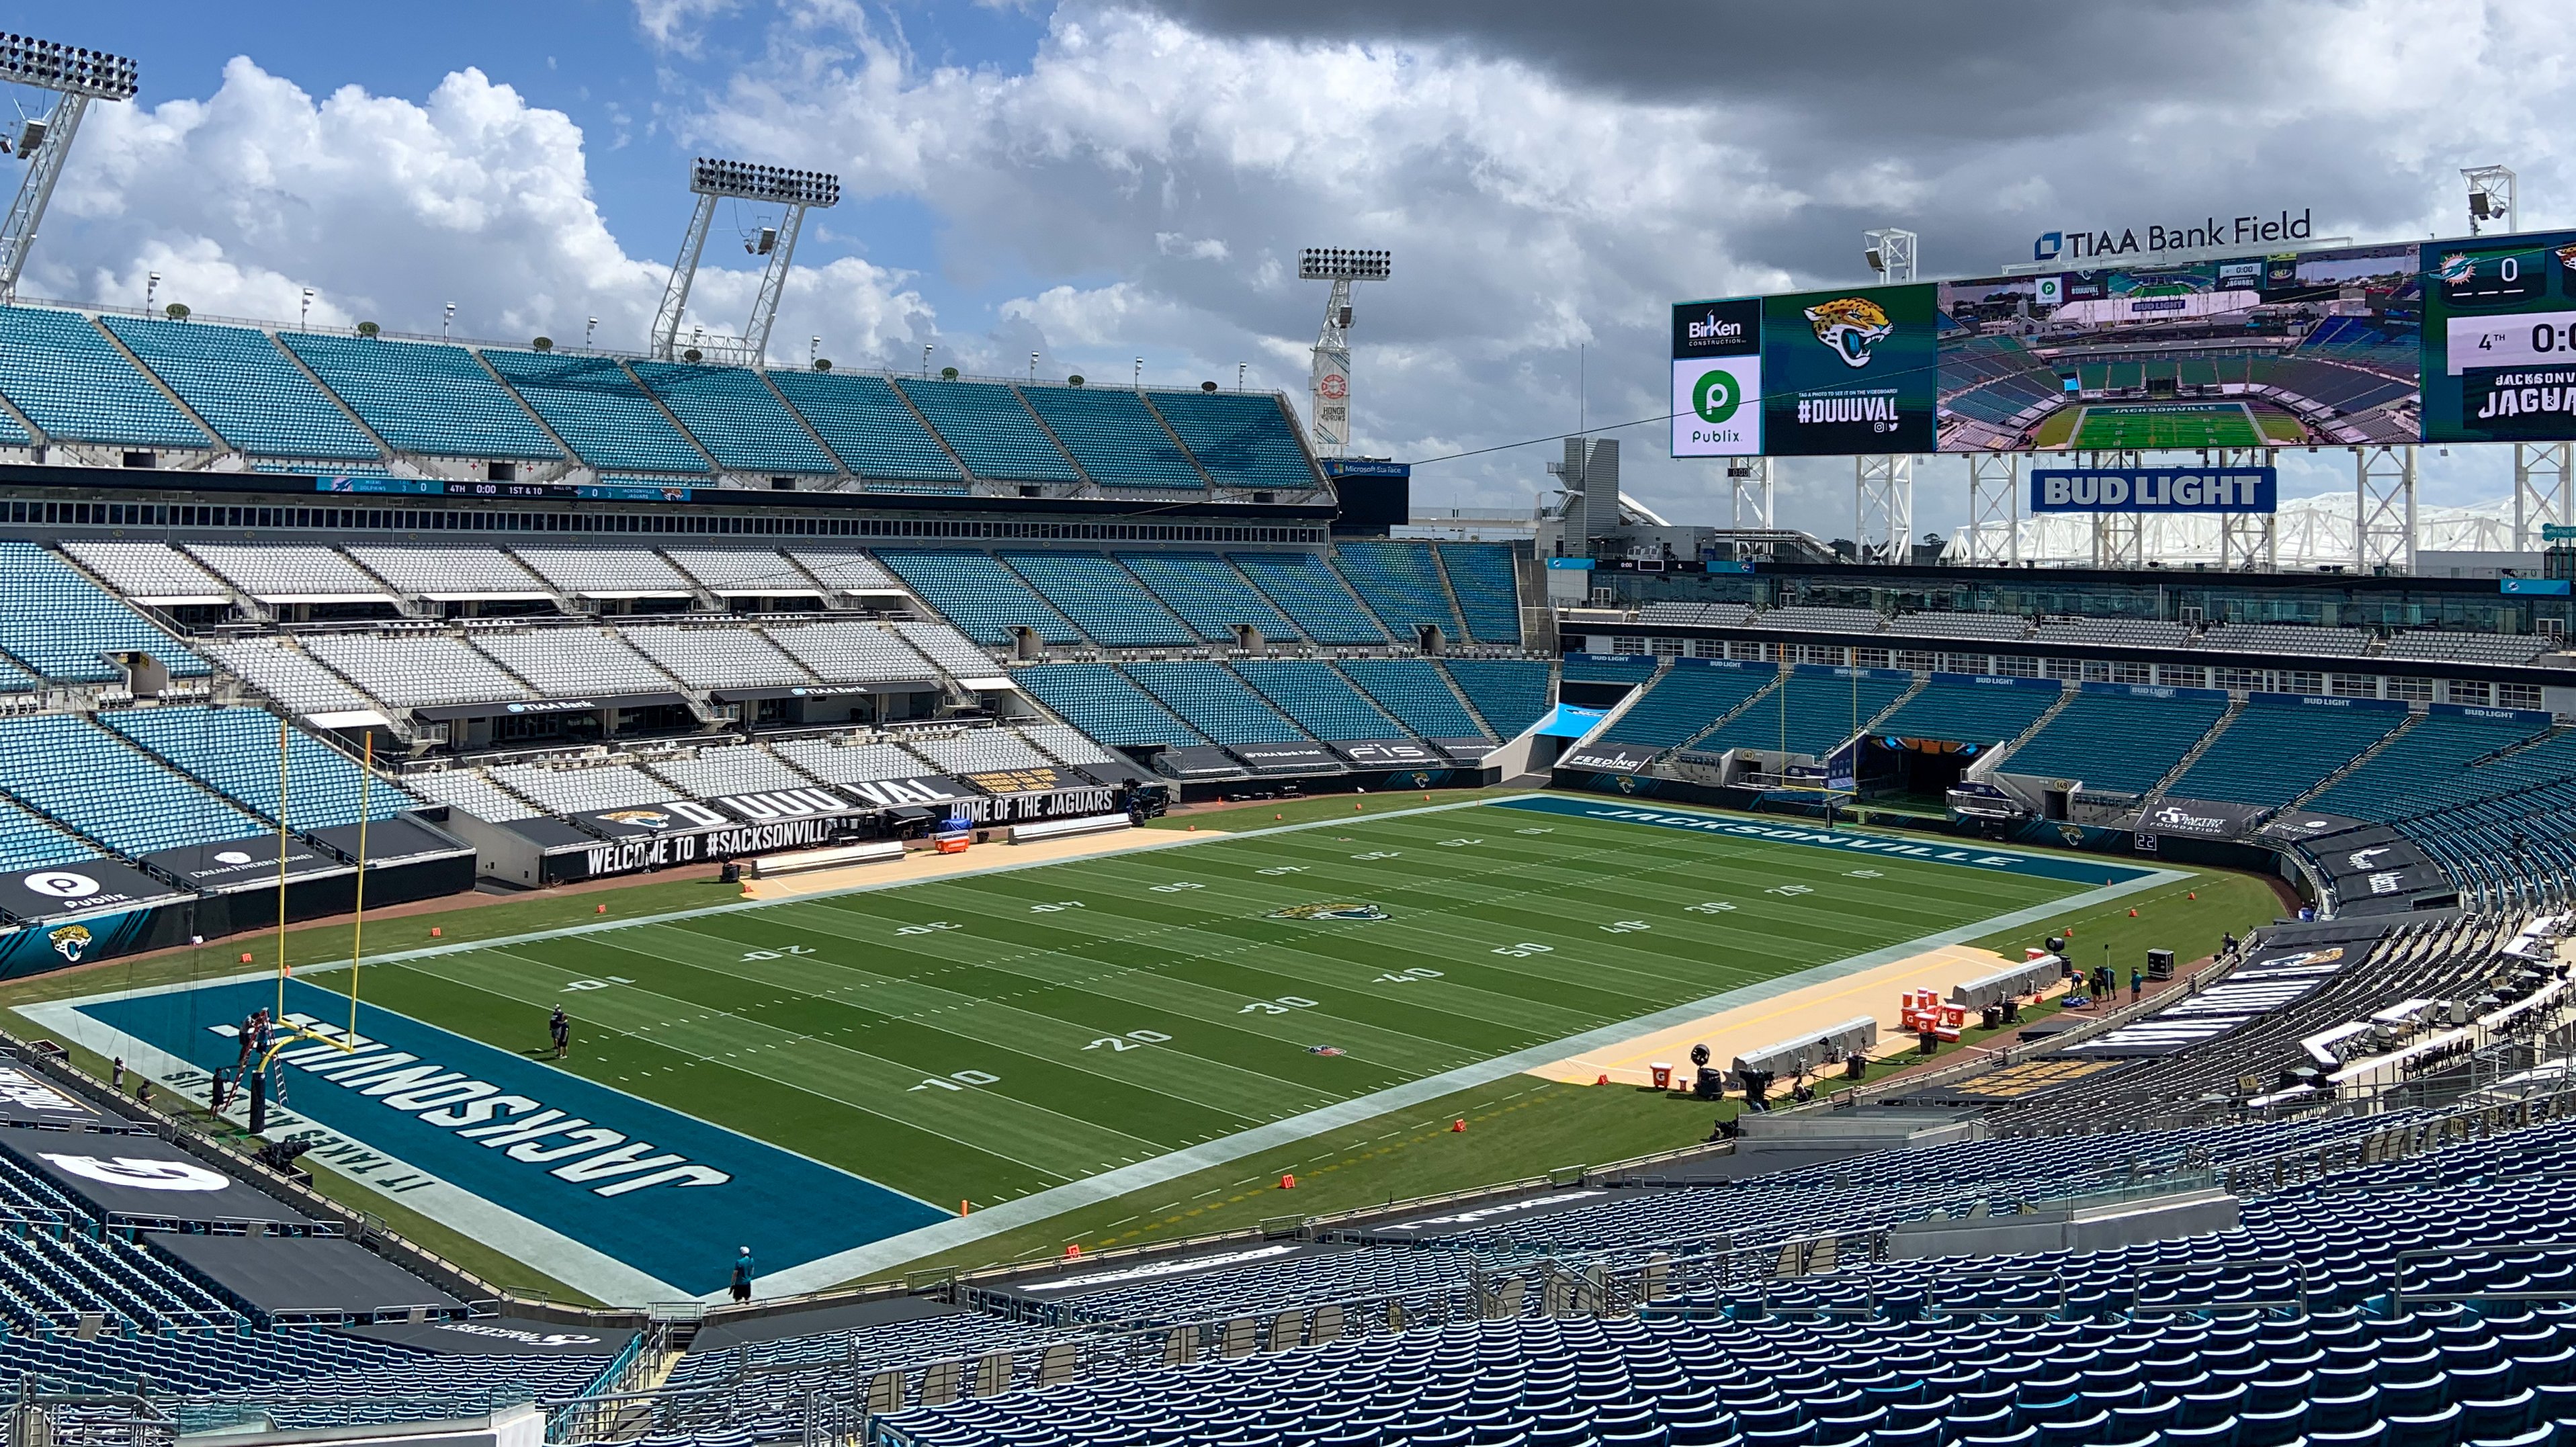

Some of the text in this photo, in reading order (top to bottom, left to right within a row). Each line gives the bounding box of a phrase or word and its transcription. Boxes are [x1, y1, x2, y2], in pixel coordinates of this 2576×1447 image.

[2066, 208, 2311, 258] TIAA Bank Field
[2501, 258, 2518, 281] 0
[1798, 397, 1898, 423] #DUUUVAL
[2110, 406, 2217, 414] JACKSONVILLE
[1692, 430, 1740, 443] Publix
[476, 485, 496, 494] 0:00
[2044, 475, 2262, 505] BUD LIGHT
[836, 685, 867, 693] Bank
[2131, 686, 2176, 696] BUD LIGHT
[523, 700, 595, 711] TIAA Bank
[2304, 697, 2350, 707] BUD LIGHT
[2464, 707, 2514, 718] BUD LIGHT
[1254, 750, 1277, 758] TIAA
[1573, 752, 1639, 767] FEEDING
[968, 773, 1011, 781] THANKS
[975, 777, 1021, 786] HEROES
[984, 784, 1023, 793] FRONT
[951, 791, 1113, 823] HOME OF THE JAGUARS
[2150, 822, 2221, 833] FOUNDATION
[1586, 809, 2023, 867] JACKSONVILLE
[2137, 835, 2154, 847] 22
[588, 843, 668, 875] WELCOME
[675, 836, 694, 862] TO
[191, 864, 230, 878] DREAM
[232, 859, 276, 873] FINDERS
[1842, 870, 1884, 879] 10
[1764, 885, 1814, 896] 20
[65, 893, 128, 908] Publix
[1684, 902, 1737, 914] 30
[1599, 921, 1651, 933] 40
[1491, 942, 1553, 958] 50
[1387, 967, 1445, 983] 40
[1251, 996, 1319, 1014] 30
[1948, 1012, 1957, 1020] G
[1919, 1021, 1928, 1030] G
[1097, 1029, 1172, 1053] 20
[922, 1069, 1000, 1091] 10
[1656, 1071, 1666, 1082] G
[2243, 1078, 2252, 1086] 12
[208, 1012, 734, 1198] JACKSONVILLE
[285, 1129, 392, 1174] TAKES
[375, 1174, 435, 1193] IT
